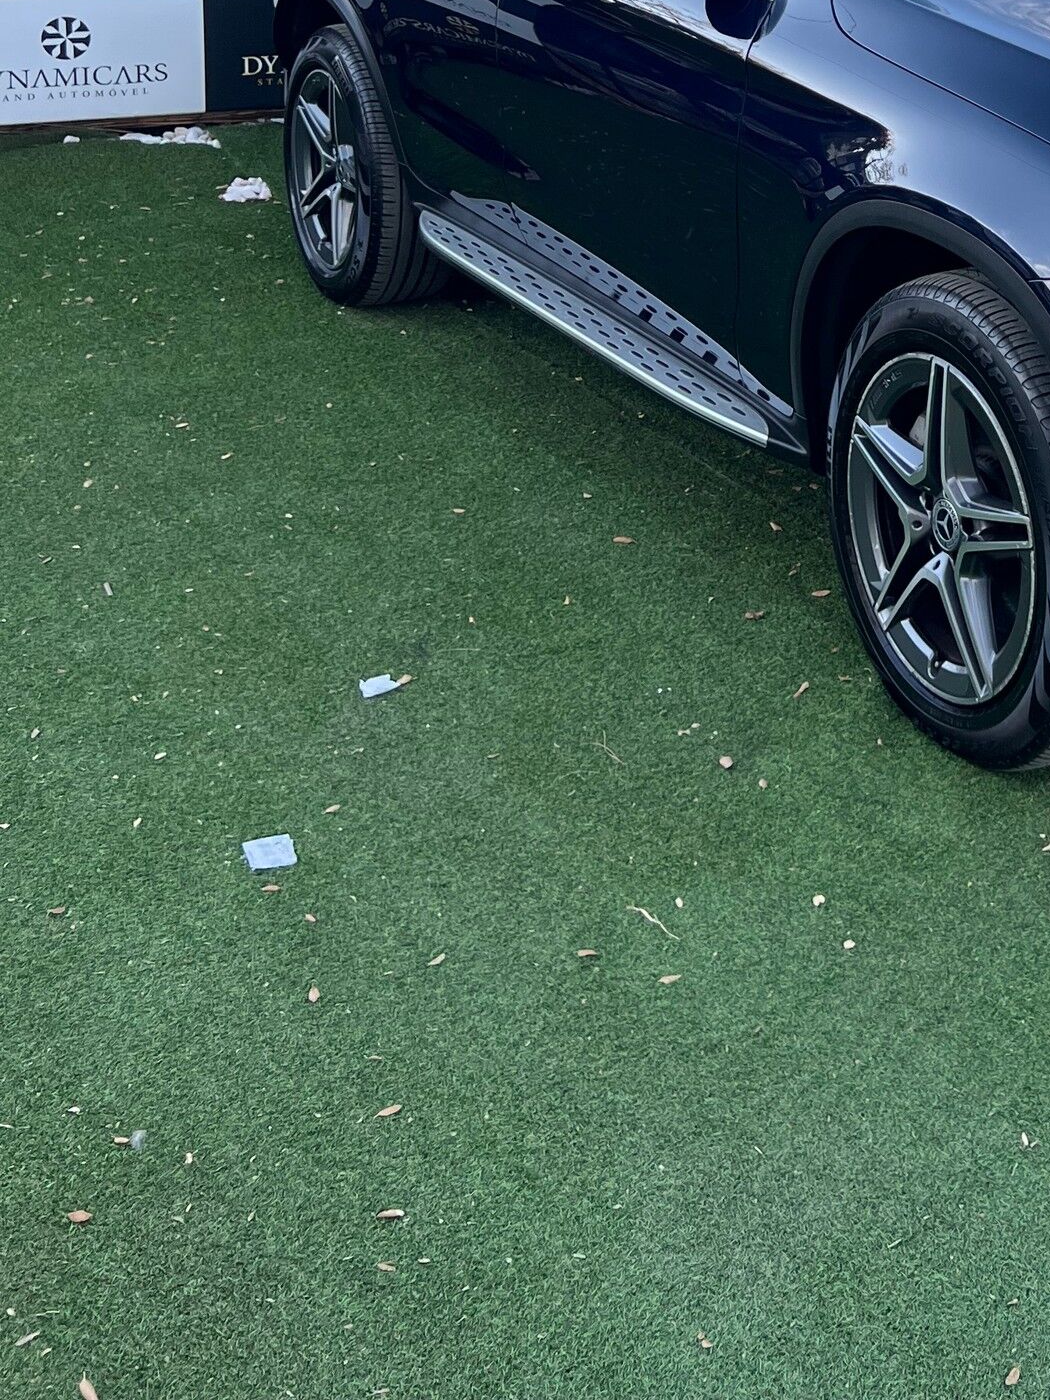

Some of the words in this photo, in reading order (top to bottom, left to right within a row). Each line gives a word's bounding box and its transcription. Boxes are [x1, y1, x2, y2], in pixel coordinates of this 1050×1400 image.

[241, 55, 285, 76] DY
[0, 63, 168, 90] NAMICARS
[257, 78, 284, 86] STA
[2, 93, 36, 102] AND
[47, 87, 150, 99] AUTOMÓVEL
